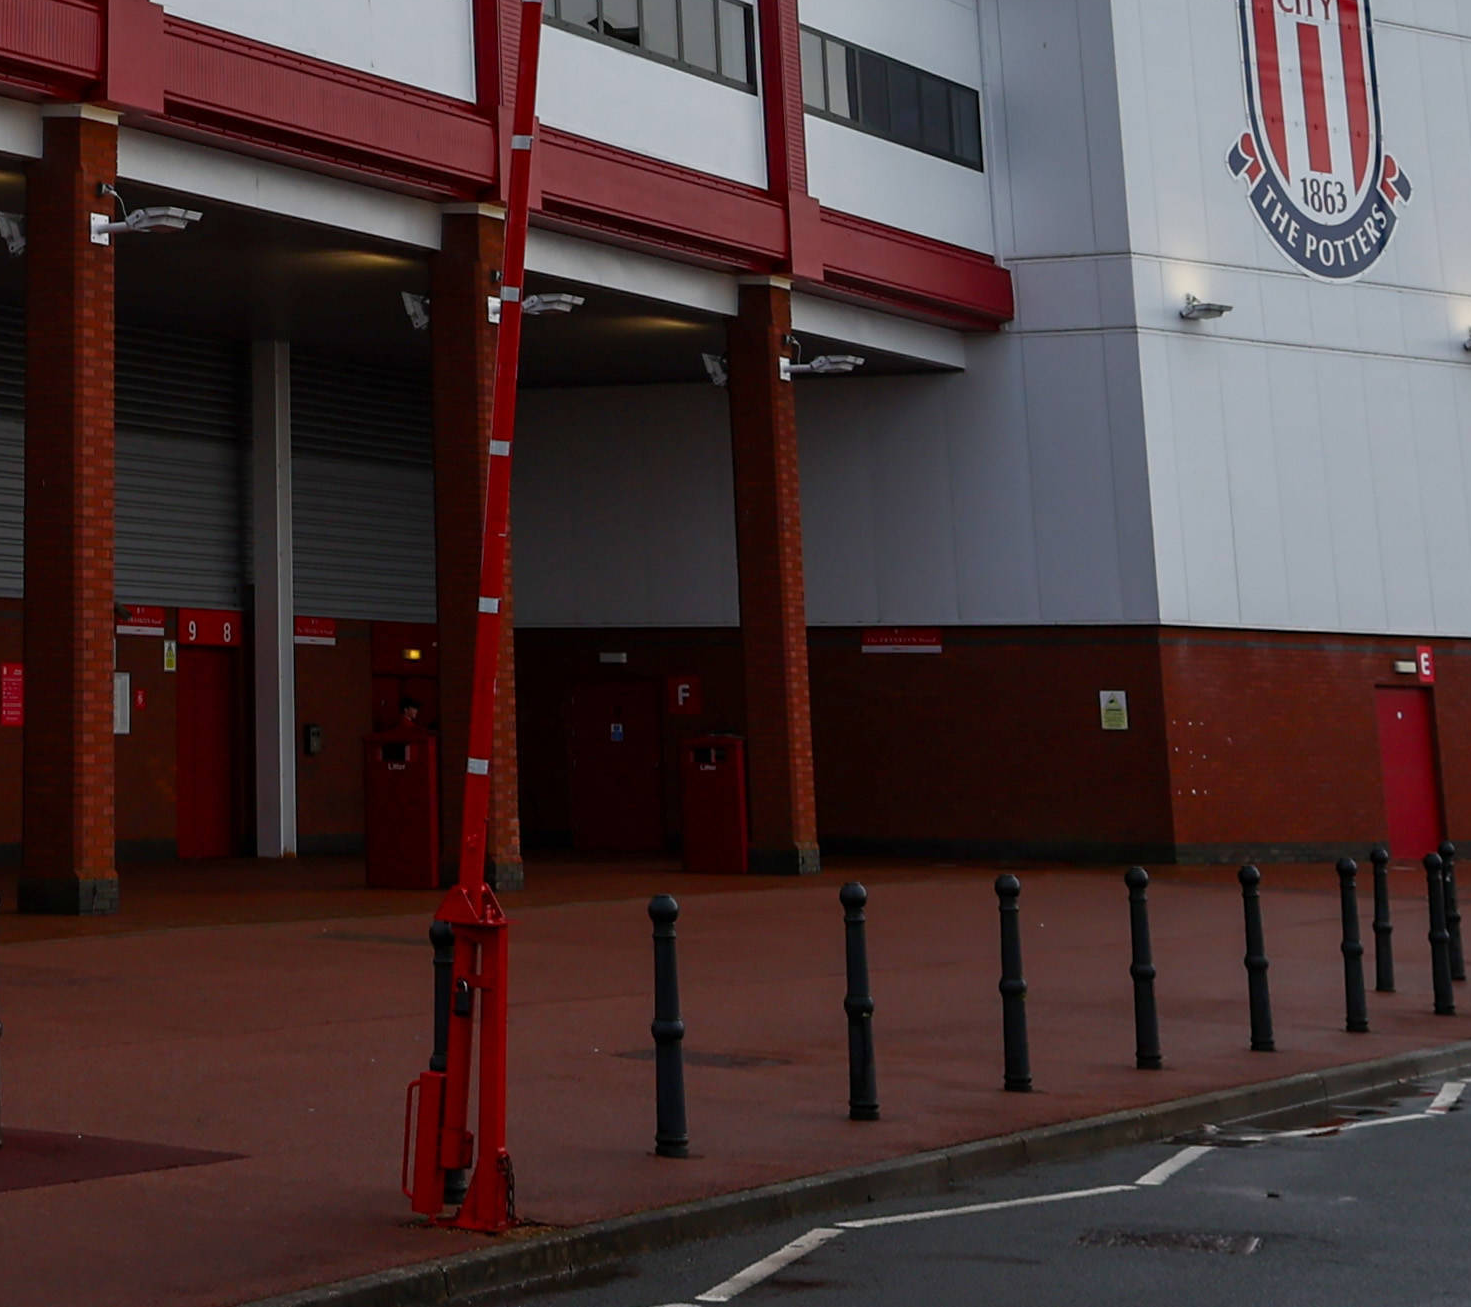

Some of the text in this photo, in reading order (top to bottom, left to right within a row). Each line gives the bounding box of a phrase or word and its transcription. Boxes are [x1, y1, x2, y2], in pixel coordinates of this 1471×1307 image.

[1300, 178, 1348, 215] 1863
[1262, 184, 1388, 267] THE POTTERS
[189, 620, 231, 642] 9 8
[1421, 653, 1431, 675] E
[677, 683, 690, 706] F
